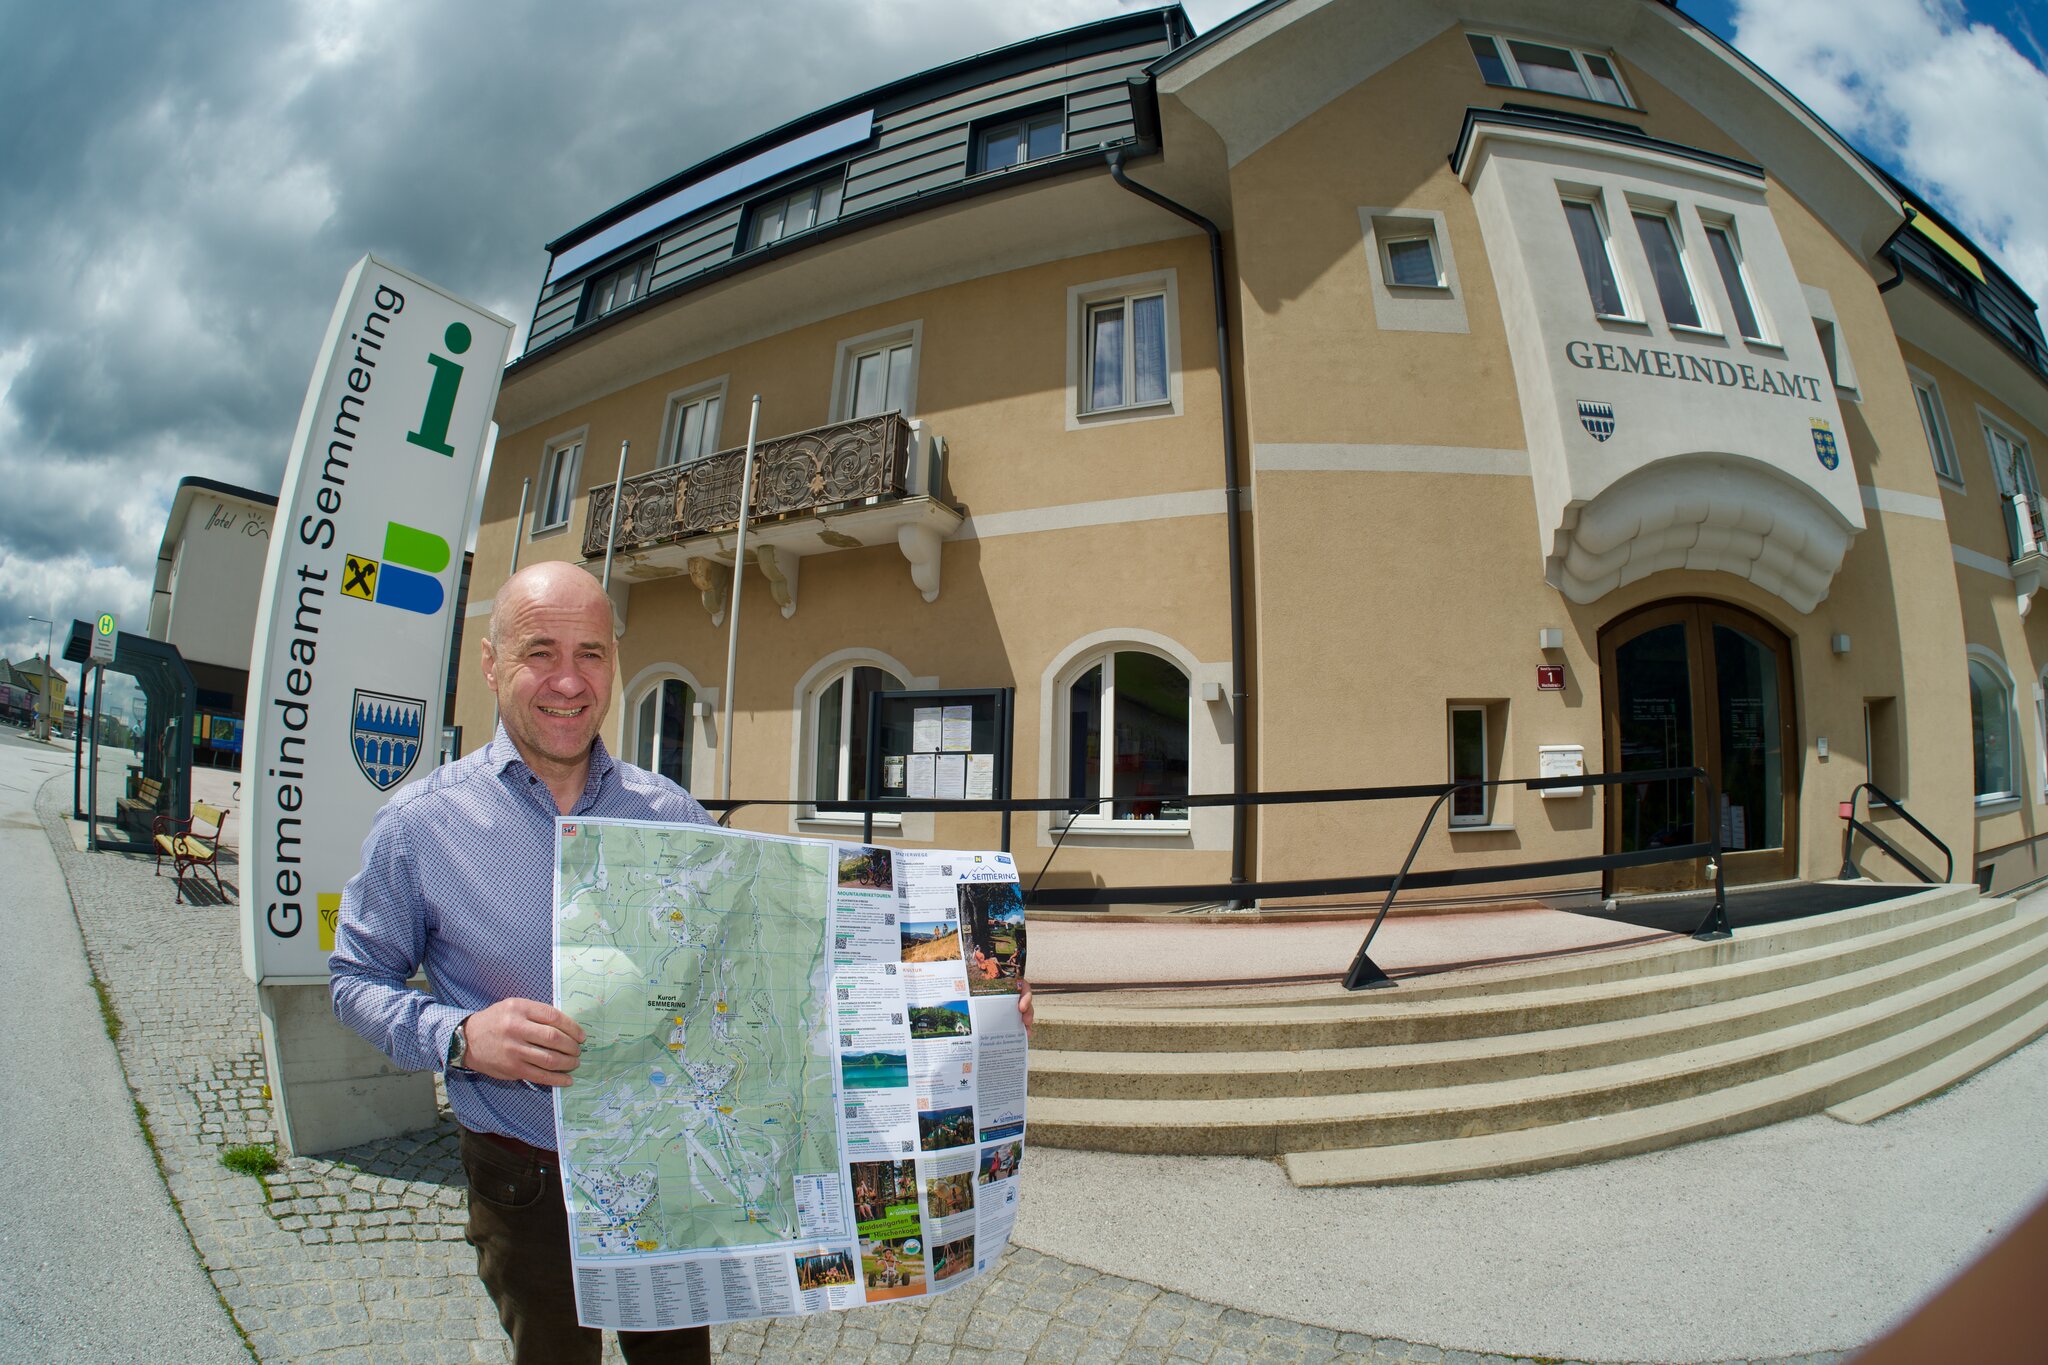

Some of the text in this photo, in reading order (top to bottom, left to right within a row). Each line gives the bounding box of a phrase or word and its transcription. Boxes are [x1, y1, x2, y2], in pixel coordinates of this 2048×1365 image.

[1565, 341, 1822, 402] GEMEINDEAMT
[204, 503, 237, 531] Hotel
[267, 284, 405, 939] Gemeindeamt Semmering
[101, 617, 111, 632] H
[1547, 672, 1553, 683] 1
[972, 872, 1017, 882] SEMMERING
[837, 890, 892, 899] MOUNTAINBIKETOUREN
[647, 1000, 686, 1008] SEMMERING
[857, 1218, 909, 1232] Waldseilgarten
[873, 1226, 920, 1239] Hirschenkogel
